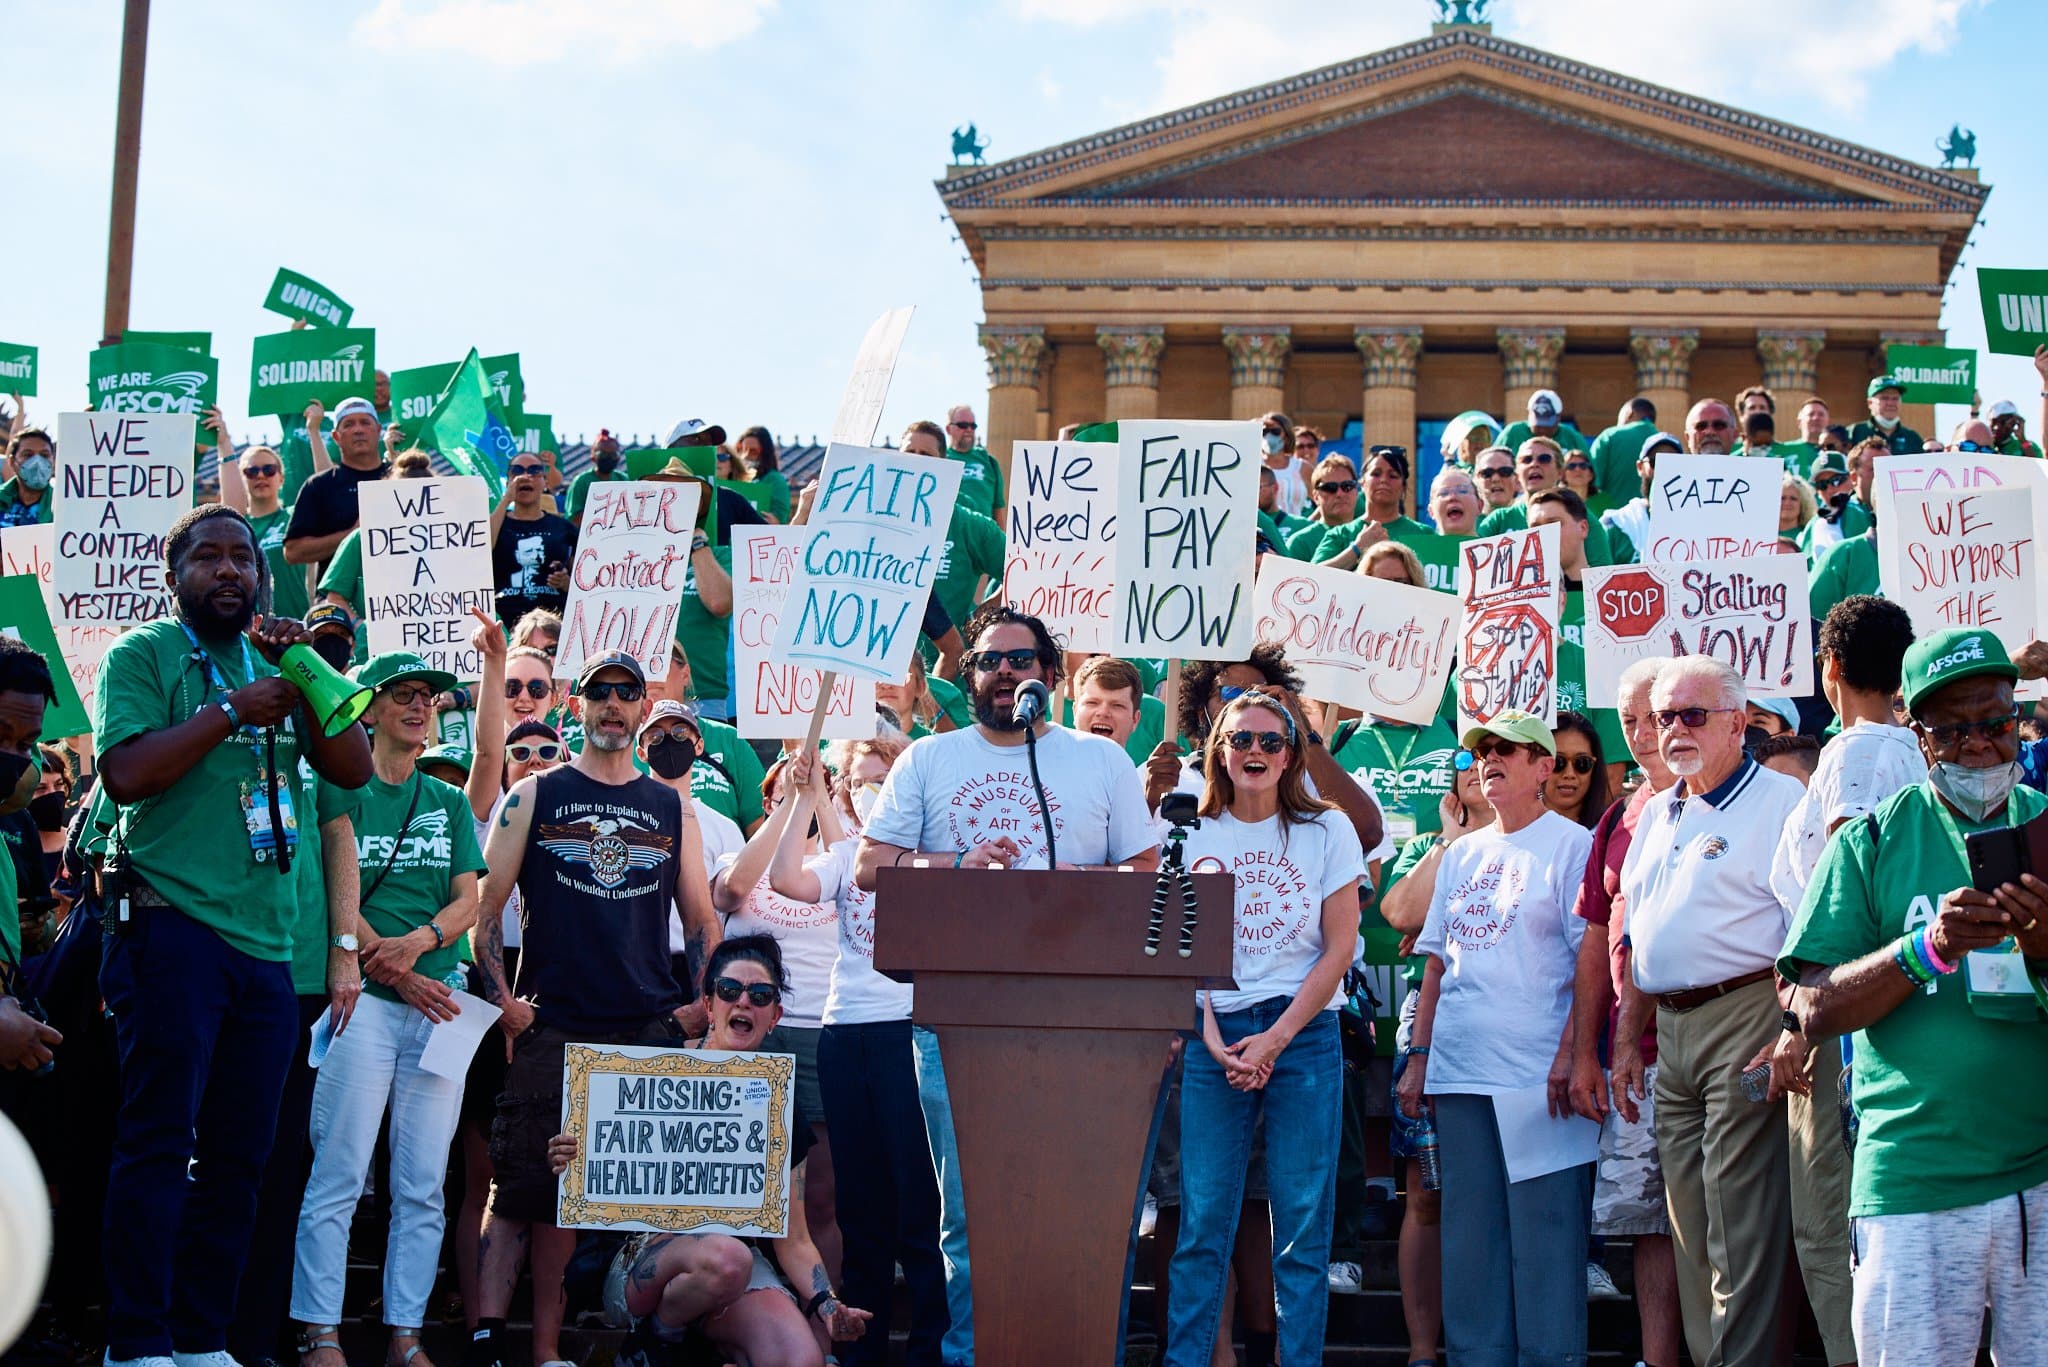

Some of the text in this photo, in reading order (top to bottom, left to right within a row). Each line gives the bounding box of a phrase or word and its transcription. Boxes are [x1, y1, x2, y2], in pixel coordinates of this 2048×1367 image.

[98, 371, 152, 391] WE ARE
[258, 359, 365, 387] SOLIDARITY
[1894, 366, 1970, 386] SOLIDARITY
[100, 391, 204, 413] AFSCME
[90, 419, 149, 456] WE
[64, 464, 184, 498] NEEDED
[1024, 446, 1098, 501] We
[1140, 435, 1241, 503] FAIR
[394, 484, 444, 517] WE
[818, 463, 937, 528] FAIR
[1663, 474, 1750, 512] FAIR
[100, 501, 120, 529] A
[587, 488, 687, 537] FAIR
[1013, 500, 1091, 548] Need
[1921, 495, 1993, 537] WE
[368, 520, 487, 557] DESERVE
[1144, 507, 1230, 570] PAY
[413, 557, 436, 586] A
[575, 545, 684, 591] Contract
[748, 536, 800, 584] FA
[804, 531, 931, 588] Contract
[1465, 530, 1546, 606] PMA
[1908, 538, 2032, 592] SUPPORT
[369, 589, 495, 621] HARRASSMENT
[1004, 557, 1114, 618] Contrac
[1602, 588, 1659, 622] STOP
[1681, 569, 1787, 622] Stalling
[793, 588, 911, 660] NOW
[1125, 580, 1241, 648] NOW
[1936, 590, 2001, 627] THE
[402, 620, 464, 647] FREE
[1257, 576, 1450, 705] Solidarity!
[296, 661, 318, 683] PYLE
[1926, 649, 1985, 677] AFSCME
[756, 660, 854, 716] NOW
[951, 772, 1061, 813] PHILADELHIA
[1351, 766, 1453, 788] AFSCME
[555, 802, 661, 830] If I Have to Explain Why
[969, 787, 1042, 817] MUSEUM
[949, 812, 968, 852] AFSCM
[988, 817, 1020, 831] ART
[593, 839, 624, 853] HARLEY
[555, 870, 660, 900] You Wouldn't Understand
[597, 872, 621, 883] USA
[1230, 851, 1306, 893] ADELPHIA
[763, 914, 809, 929] DISTRICT
[769, 902, 824, 917] UNION
[1243, 902, 1271, 916] ART
[1274, 913, 1310, 950] COUNCIL
[1304, 897, 1311, 909] 47
[1466, 904, 1492, 917] ART
[1452, 917, 1498, 938] UNION
[1484, 914, 1517, 950] COUNCIL
[618, 1077, 741, 1111] MISSING:
[594, 1120, 766, 1153] FAIR WAGES &
[587, 1160, 765, 1195] HEALTH BENEFITS
